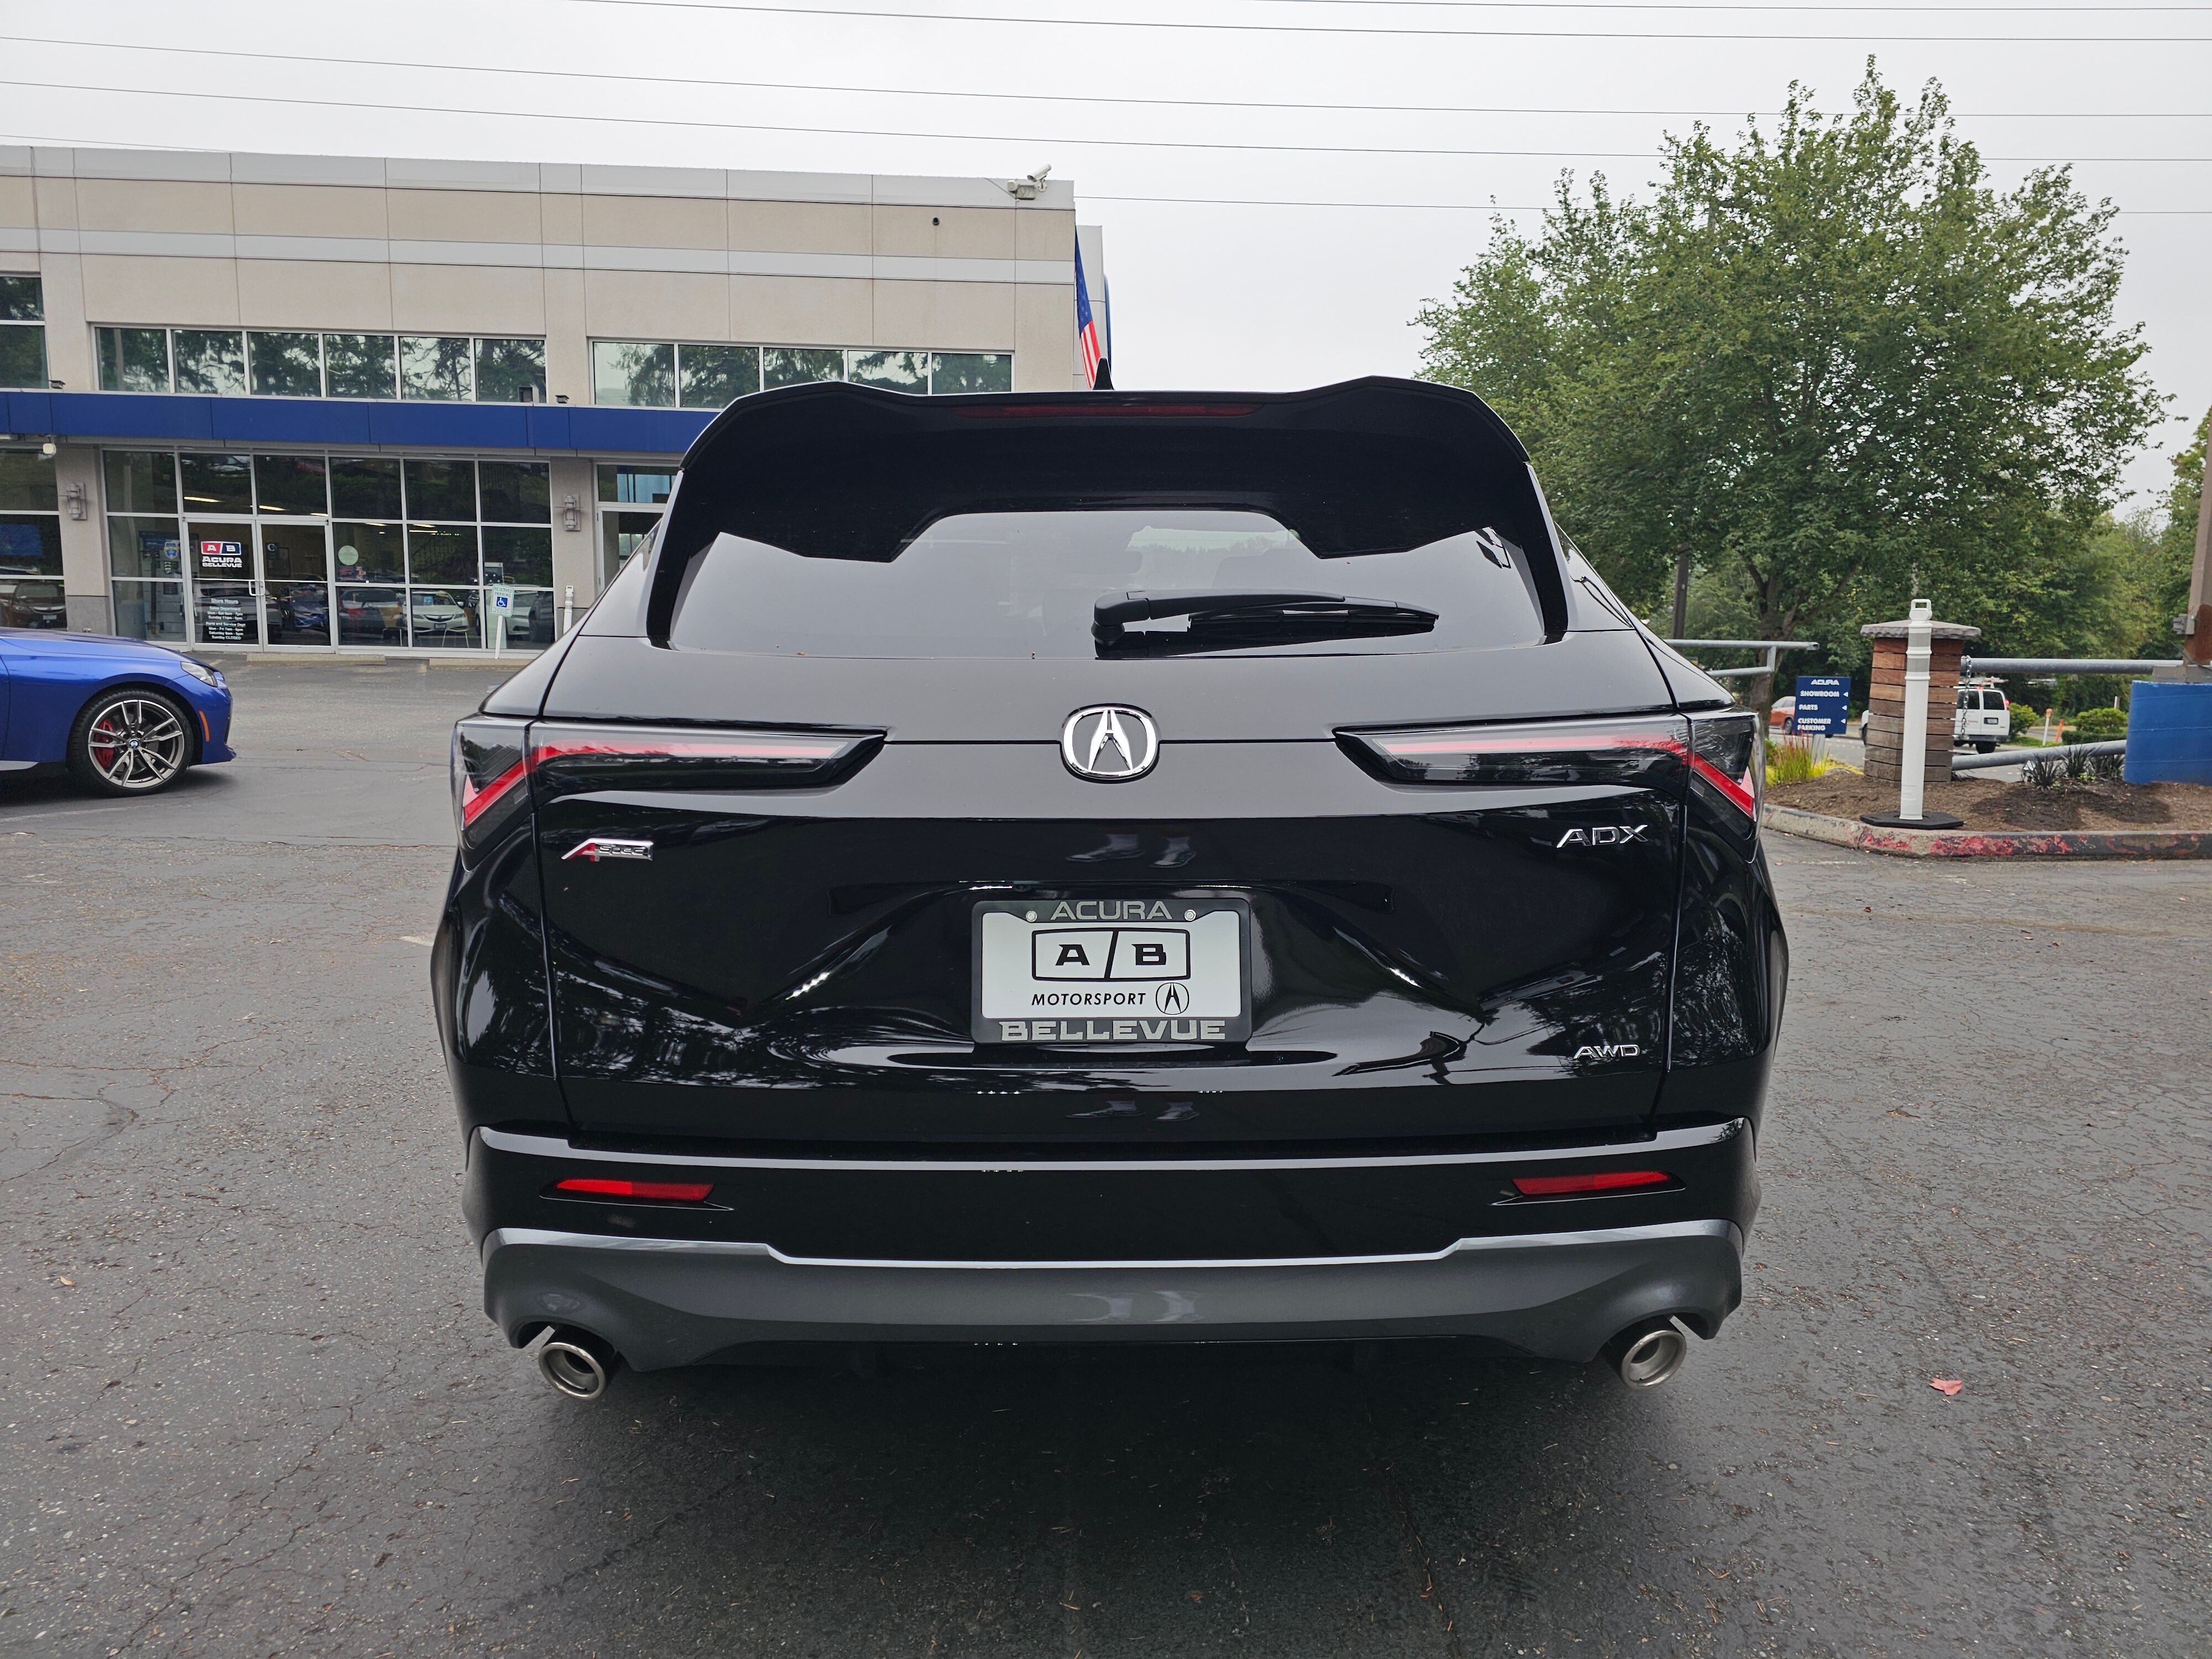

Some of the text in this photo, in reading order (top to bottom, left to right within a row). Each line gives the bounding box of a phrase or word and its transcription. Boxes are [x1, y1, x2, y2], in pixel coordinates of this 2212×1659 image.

[1556, 825, 1648, 848] ADX
[1051, 901, 1172, 920] ACURA
[1056, 943, 1167, 966] A B
[1032, 993, 1146, 1006] MOTORSPORT
[999, 1020, 1226, 1041] BELLEVUE
[1573, 1045, 1641, 1059] AWD
